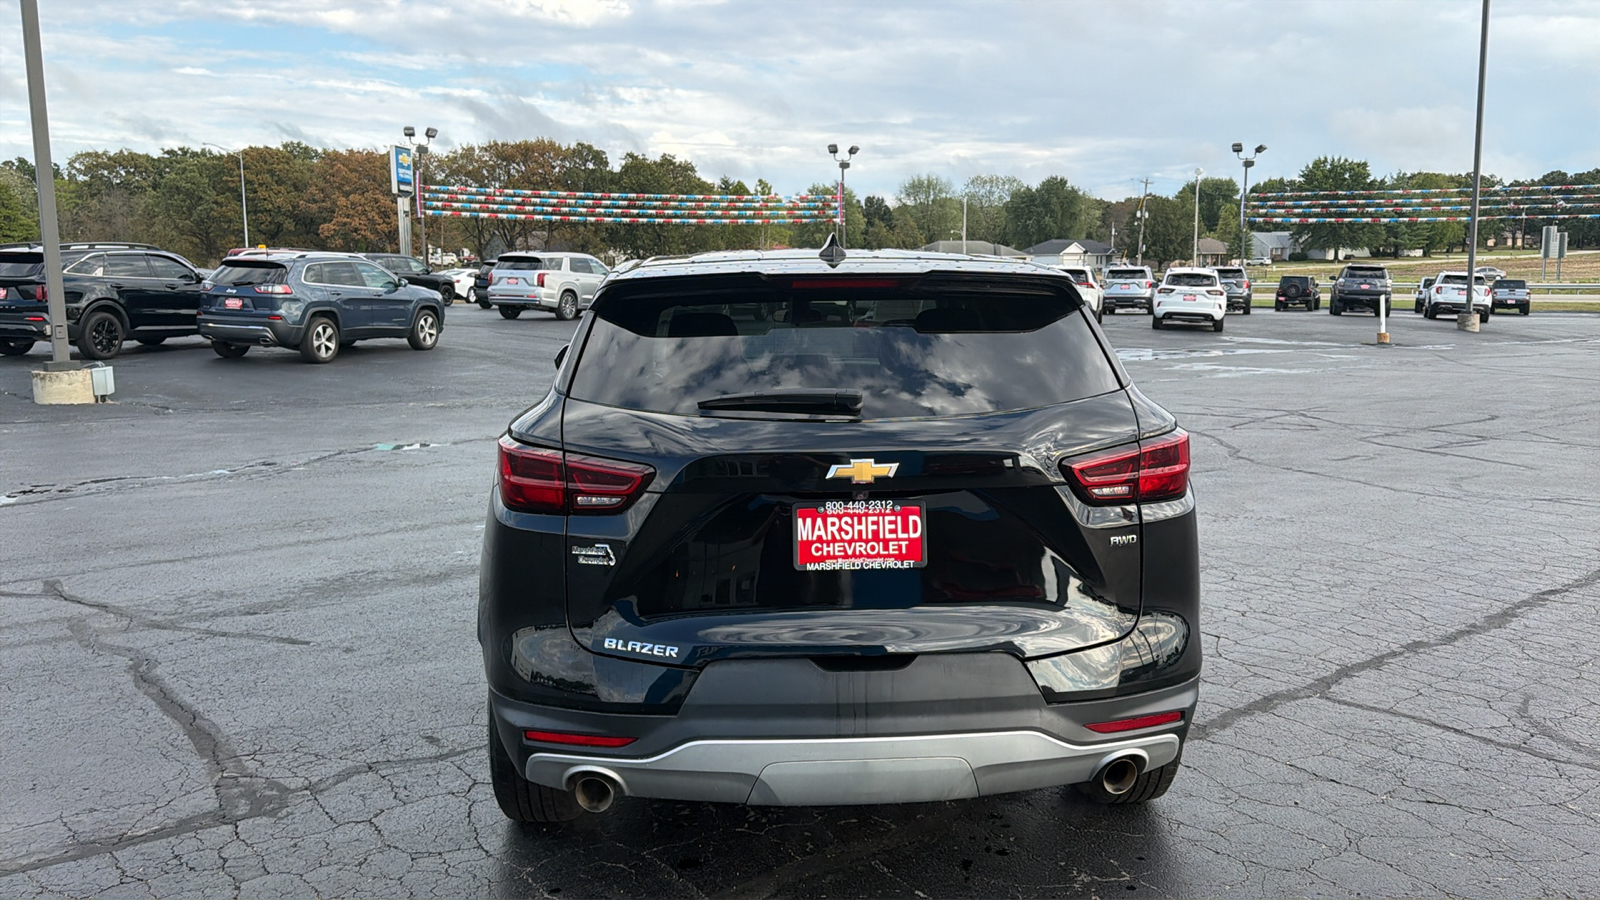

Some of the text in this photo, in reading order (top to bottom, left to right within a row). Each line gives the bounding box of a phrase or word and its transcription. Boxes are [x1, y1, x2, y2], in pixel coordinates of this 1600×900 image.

[825, 500, 893, 510] 800-440-2312
[797, 515, 922, 541] MARSHFIELD
[811, 541, 909, 556] CHEVROLET
[806, 560, 915, 571] MARSHFIELD CHEVROLET
[604, 637, 679, 657] BLAZER
